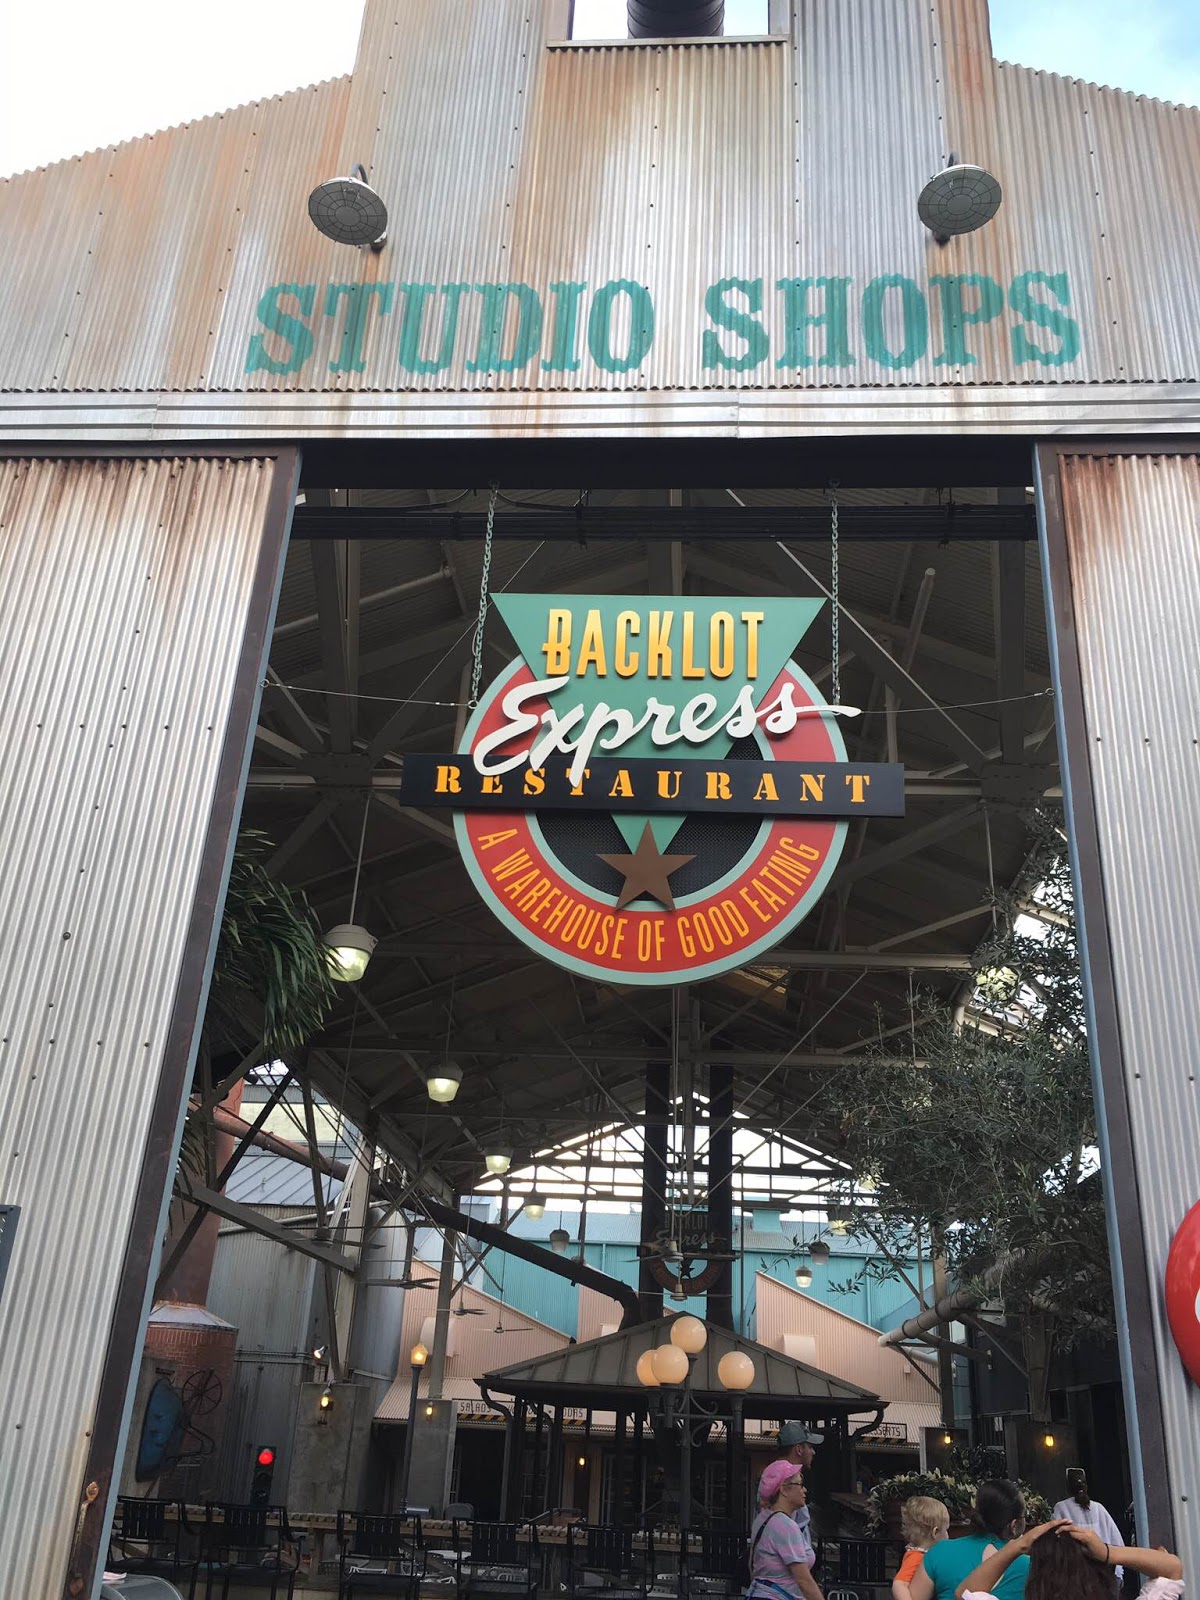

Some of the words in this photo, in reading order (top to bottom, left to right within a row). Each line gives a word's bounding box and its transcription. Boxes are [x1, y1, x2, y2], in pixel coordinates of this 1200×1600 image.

[245, 277, 656, 376] STUDIO
[701, 270, 1081, 372] SHOPS
[541, 608, 765, 679] BACKLOT
[473, 676, 862, 788] Express
[434, 764, 871, 804] RESTAURANT
[478, 828, 518, 850] A
[490, 847, 628, 961] WAREHOUSE
[738, 835, 821, 922] EATING
[637, 919, 666, 962] OF
[677, 894, 750, 958] GOOD
